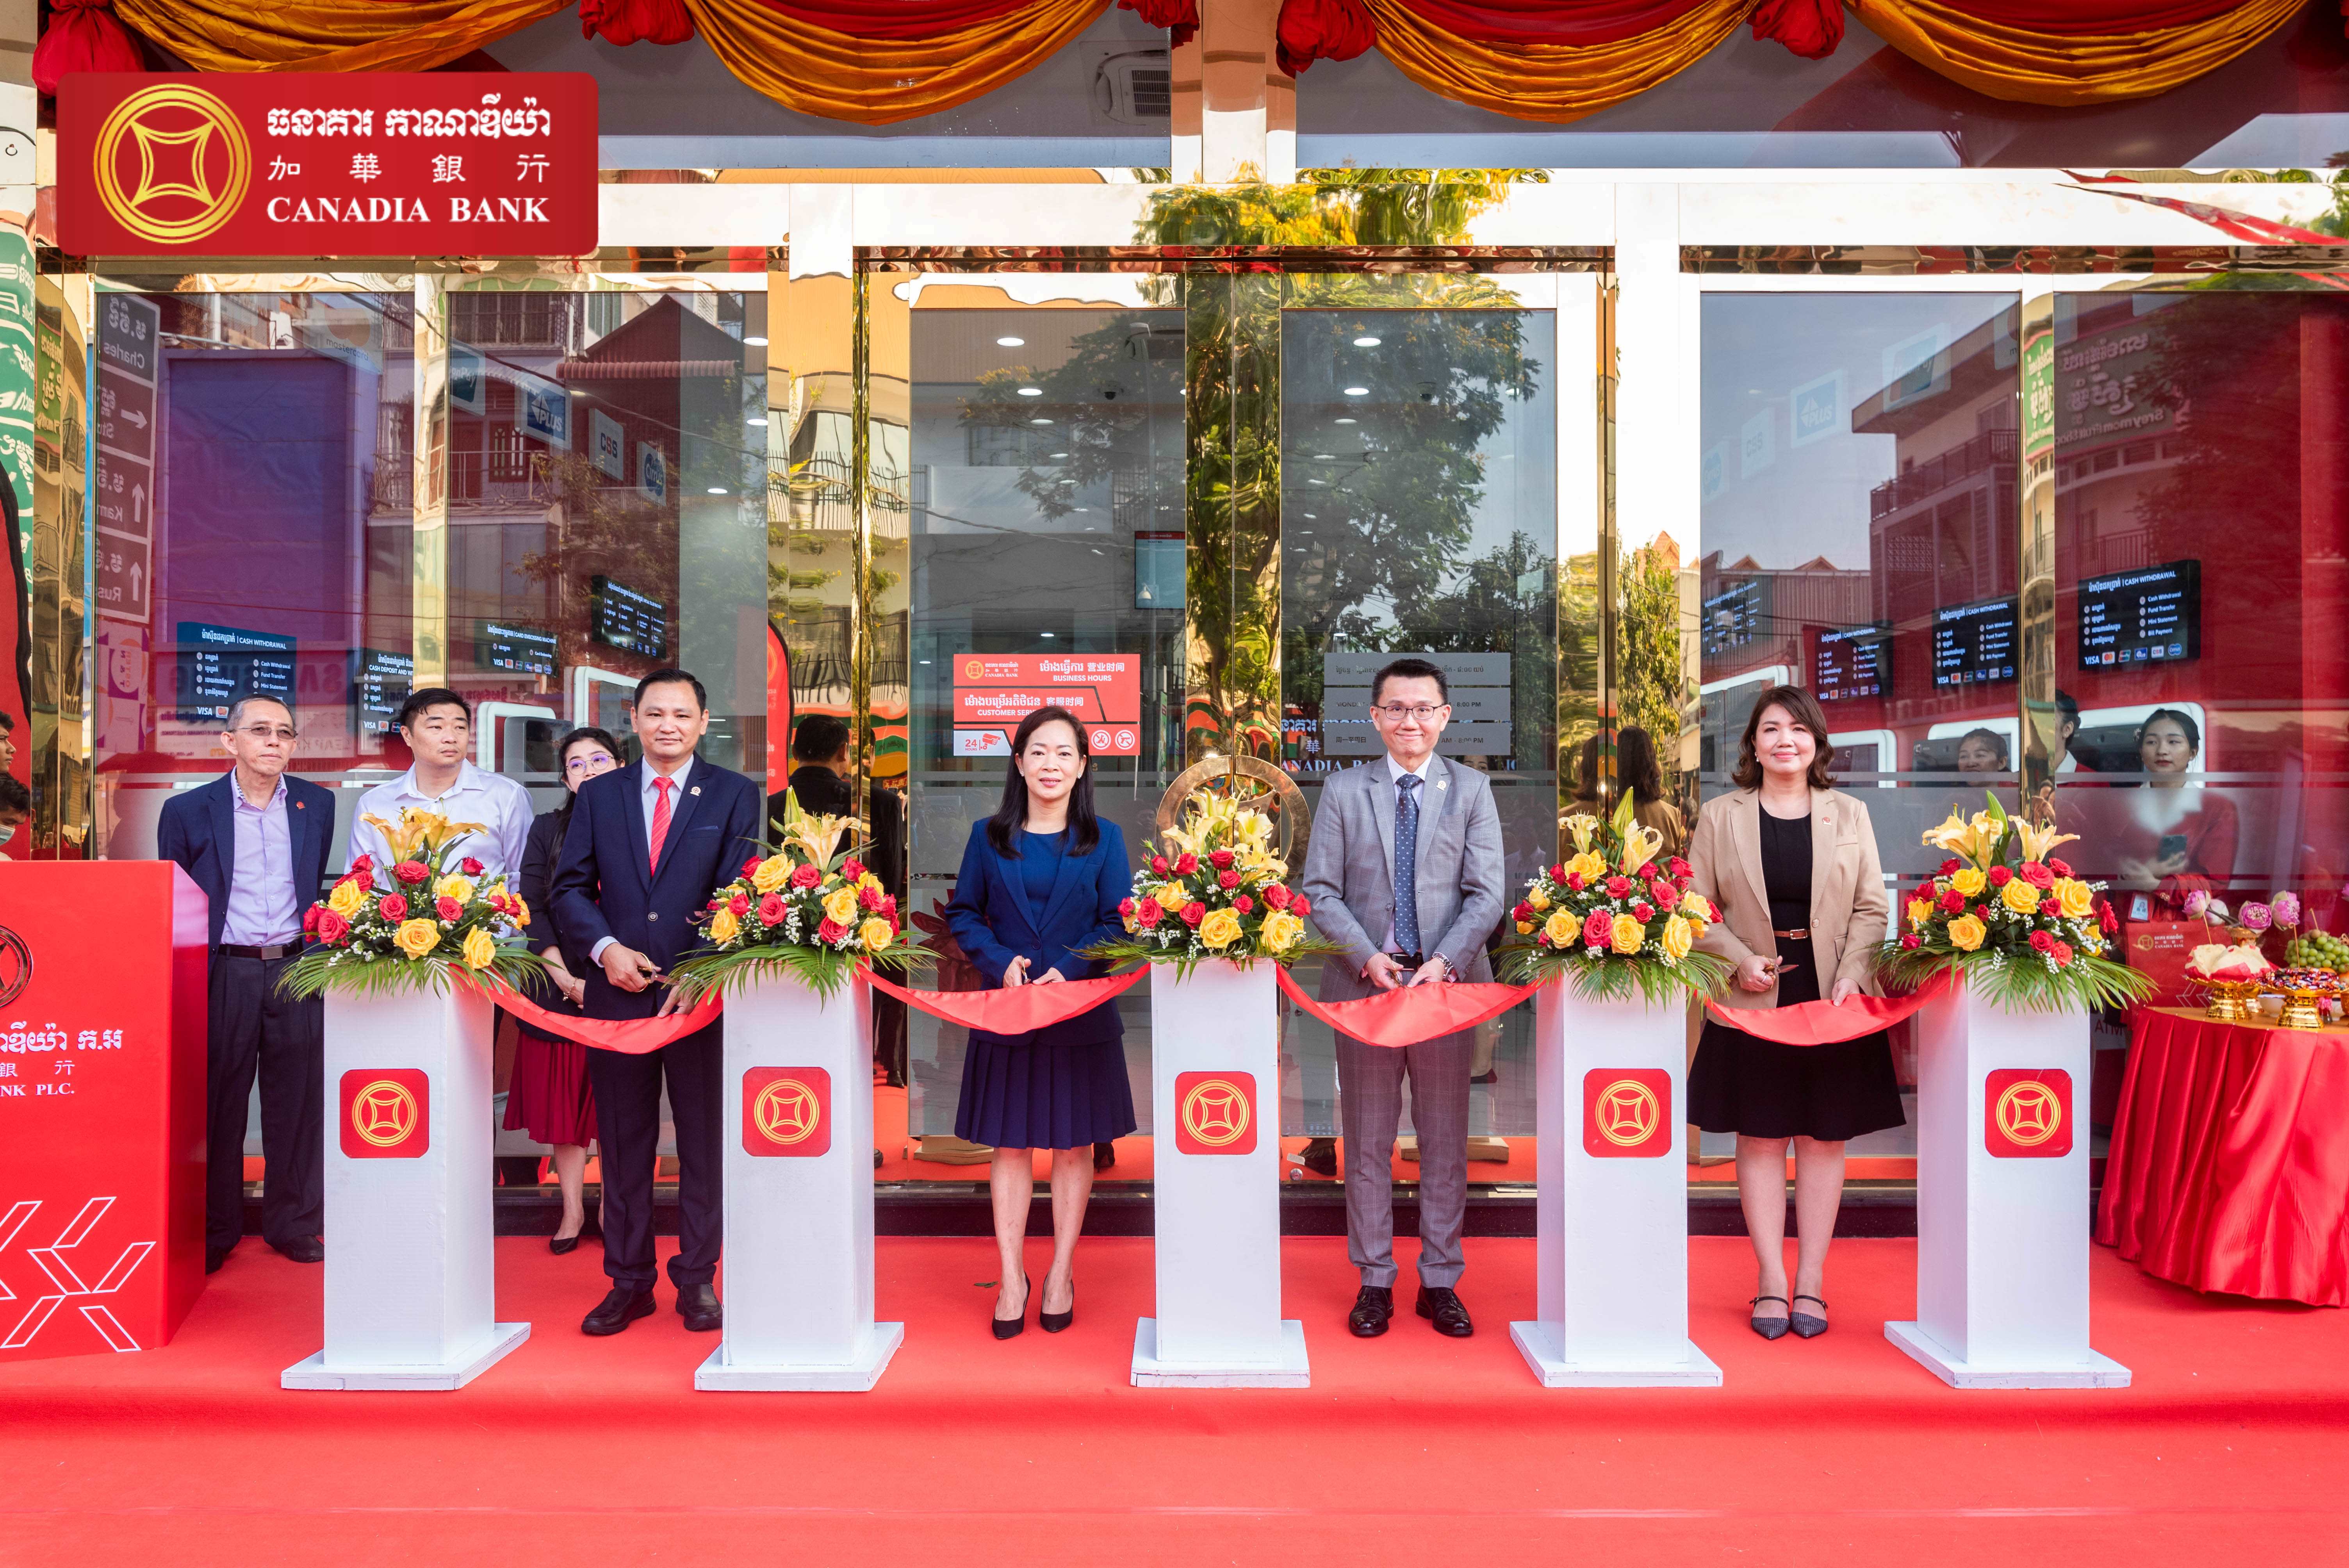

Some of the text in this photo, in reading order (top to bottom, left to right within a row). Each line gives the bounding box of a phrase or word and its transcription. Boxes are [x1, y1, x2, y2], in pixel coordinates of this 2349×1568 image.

[326, 338, 368, 360] mastercard
[451, 367, 476, 387] onPay
[539, 412, 563, 432] PLUS
[1808, 406, 1832, 427] PLUS
[601, 433, 617, 459] CSS
[1747, 431, 1763, 457] CSS
[2125, 577, 2139, 586] CASH
[2140, 571, 2176, 583] WITHDRAWAL
[1980, 602, 2008, 612] WITHDRAWAL
[202, 629, 235, 644] ម៉ាស៊ីនដកប្រាក់
[254, 640, 286, 649] WITHDRAWAL
[1039, 659, 1125, 674] ម៉ោងធ្វើការ 营业时间
[2084, 656, 2099, 665] VISA
[196, 707, 212, 715] VISA
[1281, 719, 1317, 732] នាគារ
[1281, 760, 1342, 772] ANADIA
[0, 1060, 75, 1078] 銀行
[0, 1083, 75, 1097] NK PLC.
